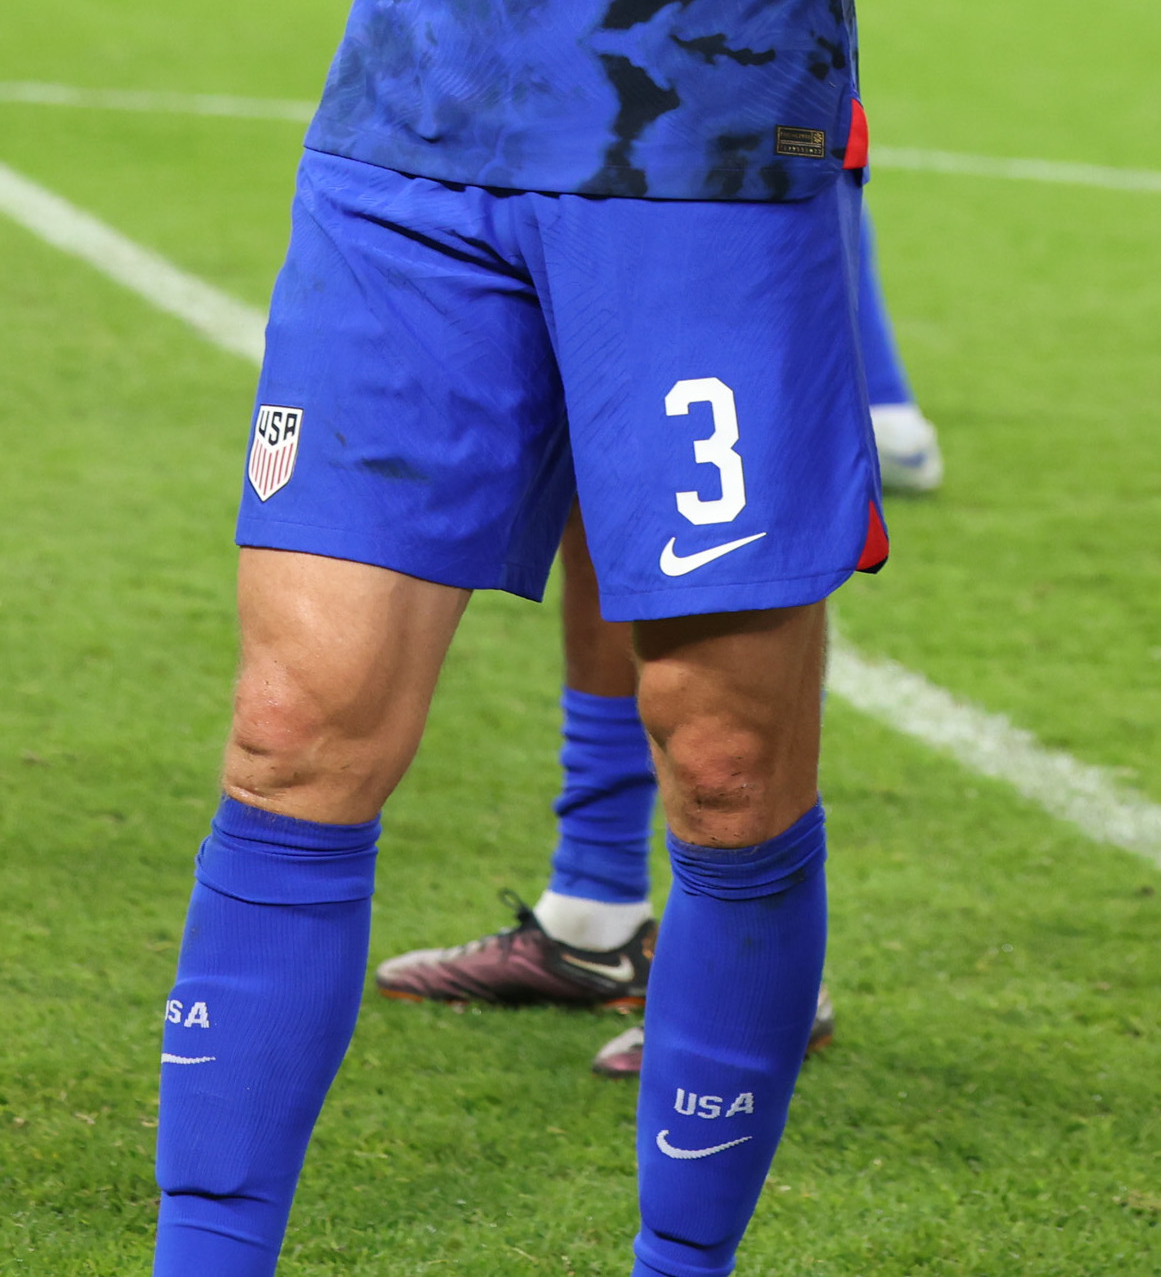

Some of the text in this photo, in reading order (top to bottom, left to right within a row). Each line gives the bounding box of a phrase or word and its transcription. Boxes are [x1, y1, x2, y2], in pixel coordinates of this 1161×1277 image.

[258, 410, 298, 446] USA
[664, 377, 747, 526] 3
[673, 1088, 755, 1119] USA
